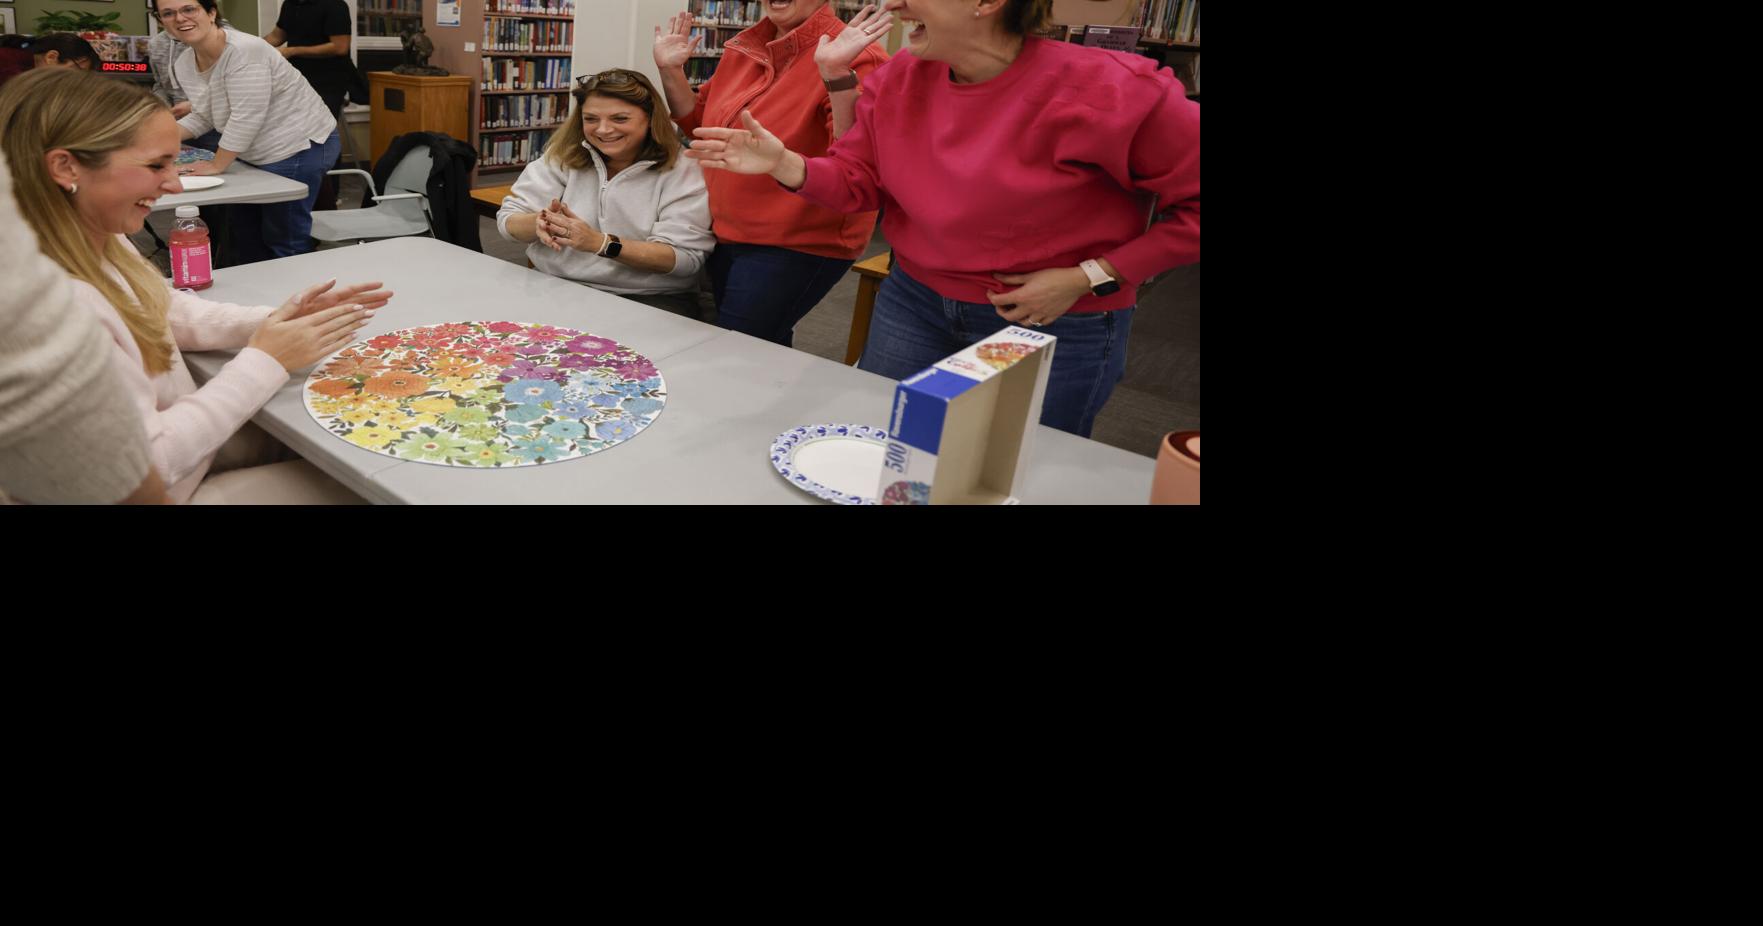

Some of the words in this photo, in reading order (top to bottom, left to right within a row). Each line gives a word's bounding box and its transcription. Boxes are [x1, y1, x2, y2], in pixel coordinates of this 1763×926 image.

[102, 62, 147, 72] 00:50:38
[1007, 328, 1046, 341] 500
[885, 443, 906, 473] 500
